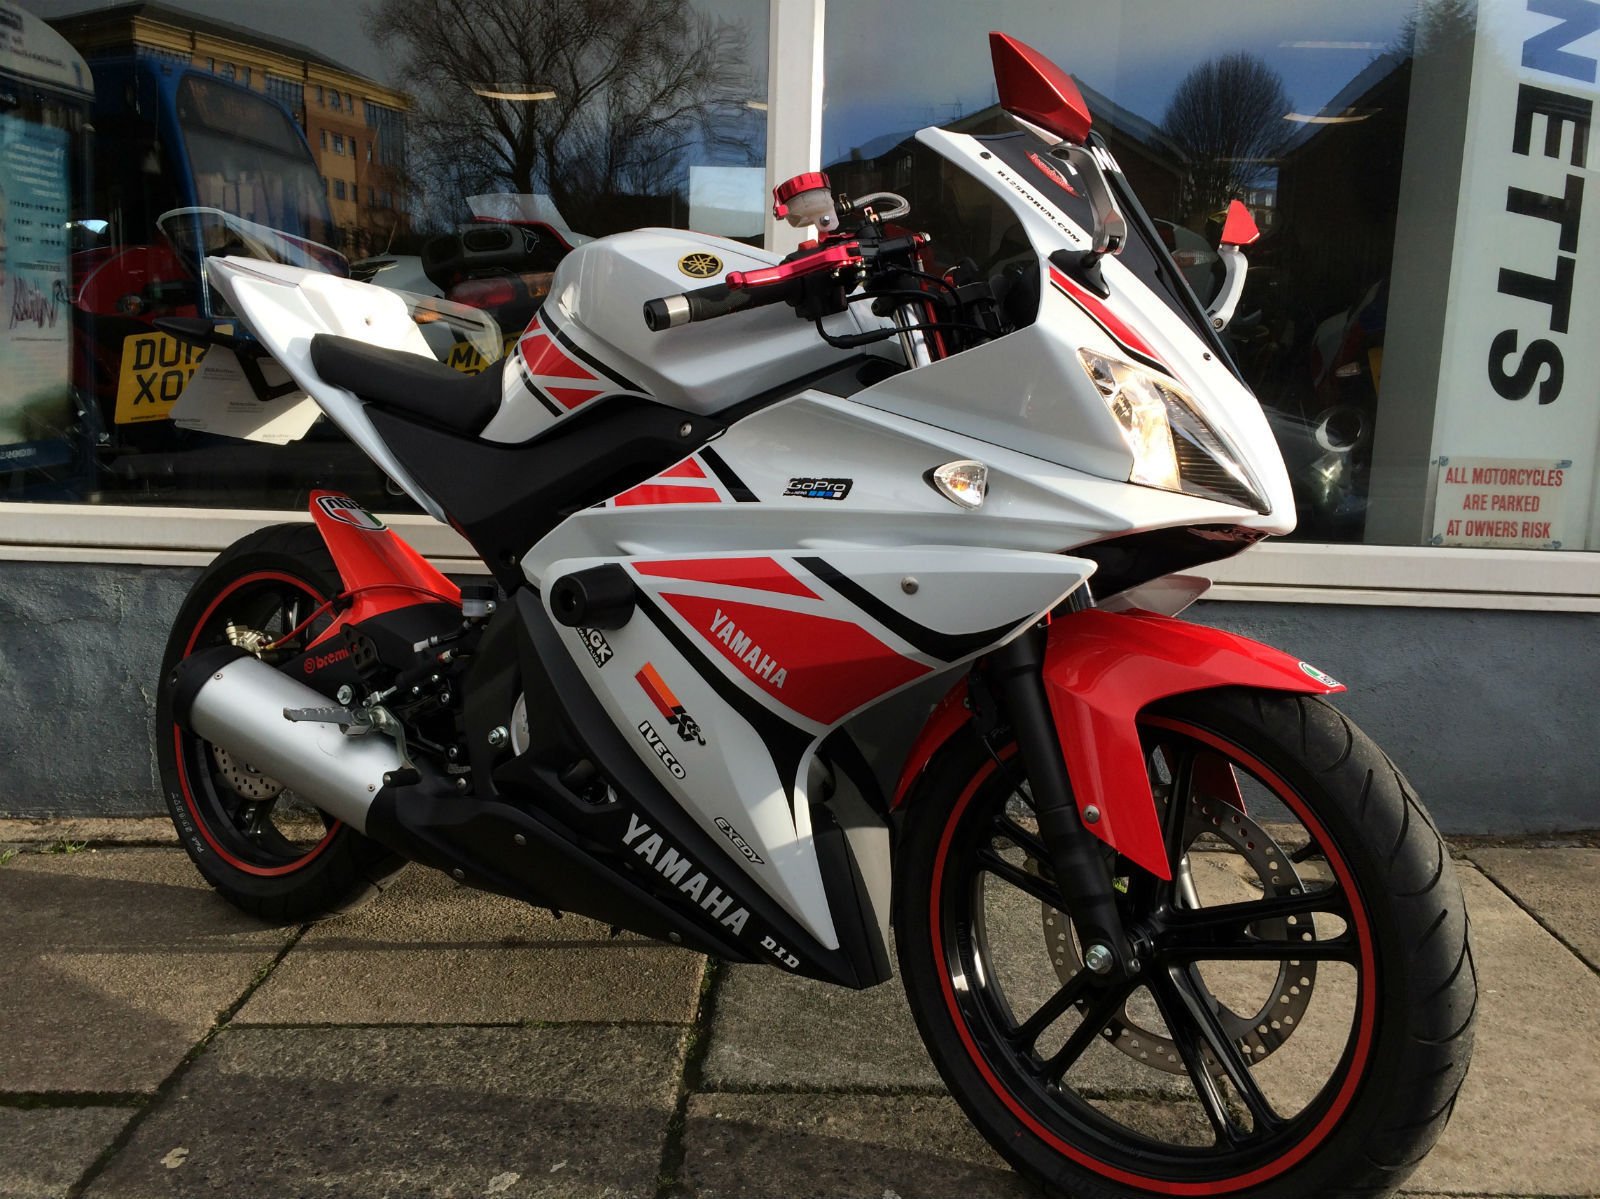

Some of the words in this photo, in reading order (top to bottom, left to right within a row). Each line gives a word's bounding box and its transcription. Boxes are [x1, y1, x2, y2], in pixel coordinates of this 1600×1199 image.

[133, 368, 195, 405] XO
[1445, 467, 1468, 484] ALL
[1472, 467, 1564, 487] MOTORCYCLES
[1463, 494, 1488, 511] ARE
[1491, 494, 1541, 512] PARKED
[1446, 519, 1462, 536] AT
[1465, 520, 1518, 538] OWNERS
[1521, 521, 1552, 538] RISK
[709, 608, 788, 689] YAMAHA
[639, 721, 686, 780] IVECO
[714, 817, 765, 864] EXEDY
[622, 812, 751, 936] YAMAHA
